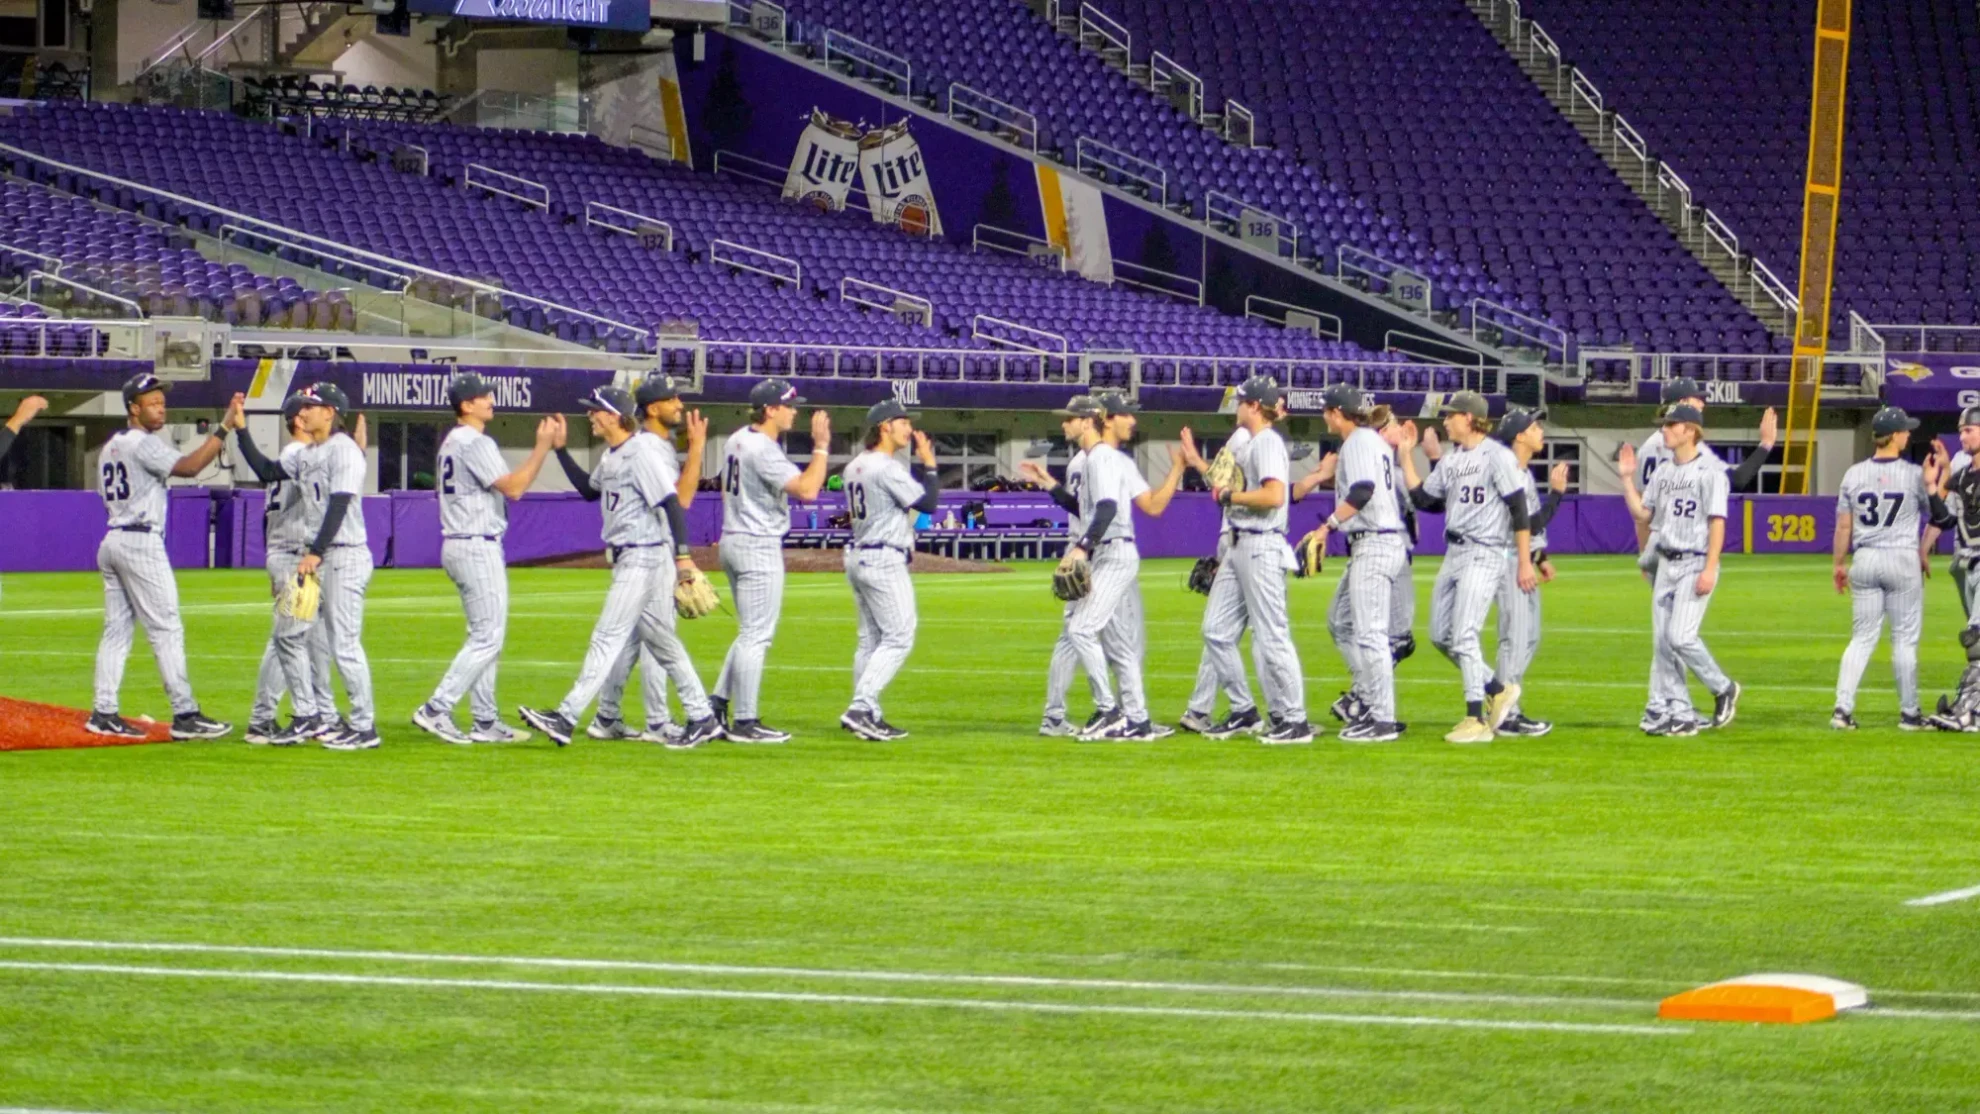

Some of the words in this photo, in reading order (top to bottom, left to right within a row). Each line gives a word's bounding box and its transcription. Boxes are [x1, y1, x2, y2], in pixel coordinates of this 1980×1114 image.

[757, 16, 779, 30] 136
[801, 141, 856, 185] Lite
[871, 151, 922, 198] Lite
[1248, 222, 1273, 237] 136
[643, 233, 665, 249] 132
[1034, 254, 1058, 268] 134
[1398, 284, 1423, 300] 136
[363, 373, 451, 405] MINNESOTA
[891, 380, 921, 404] SKOL
[1706, 381, 1743, 403] SKOL
[103, 461, 130, 501] 23
[313, 481, 321, 501] 1
[605, 490, 620, 511] 17
[848, 481, 867, 520] 13
[1460, 485, 1485, 504] 36
[1673, 498, 1697, 519] 52
[1857, 492, 1904, 527] 37
[1767, 514, 1816, 542] 328
